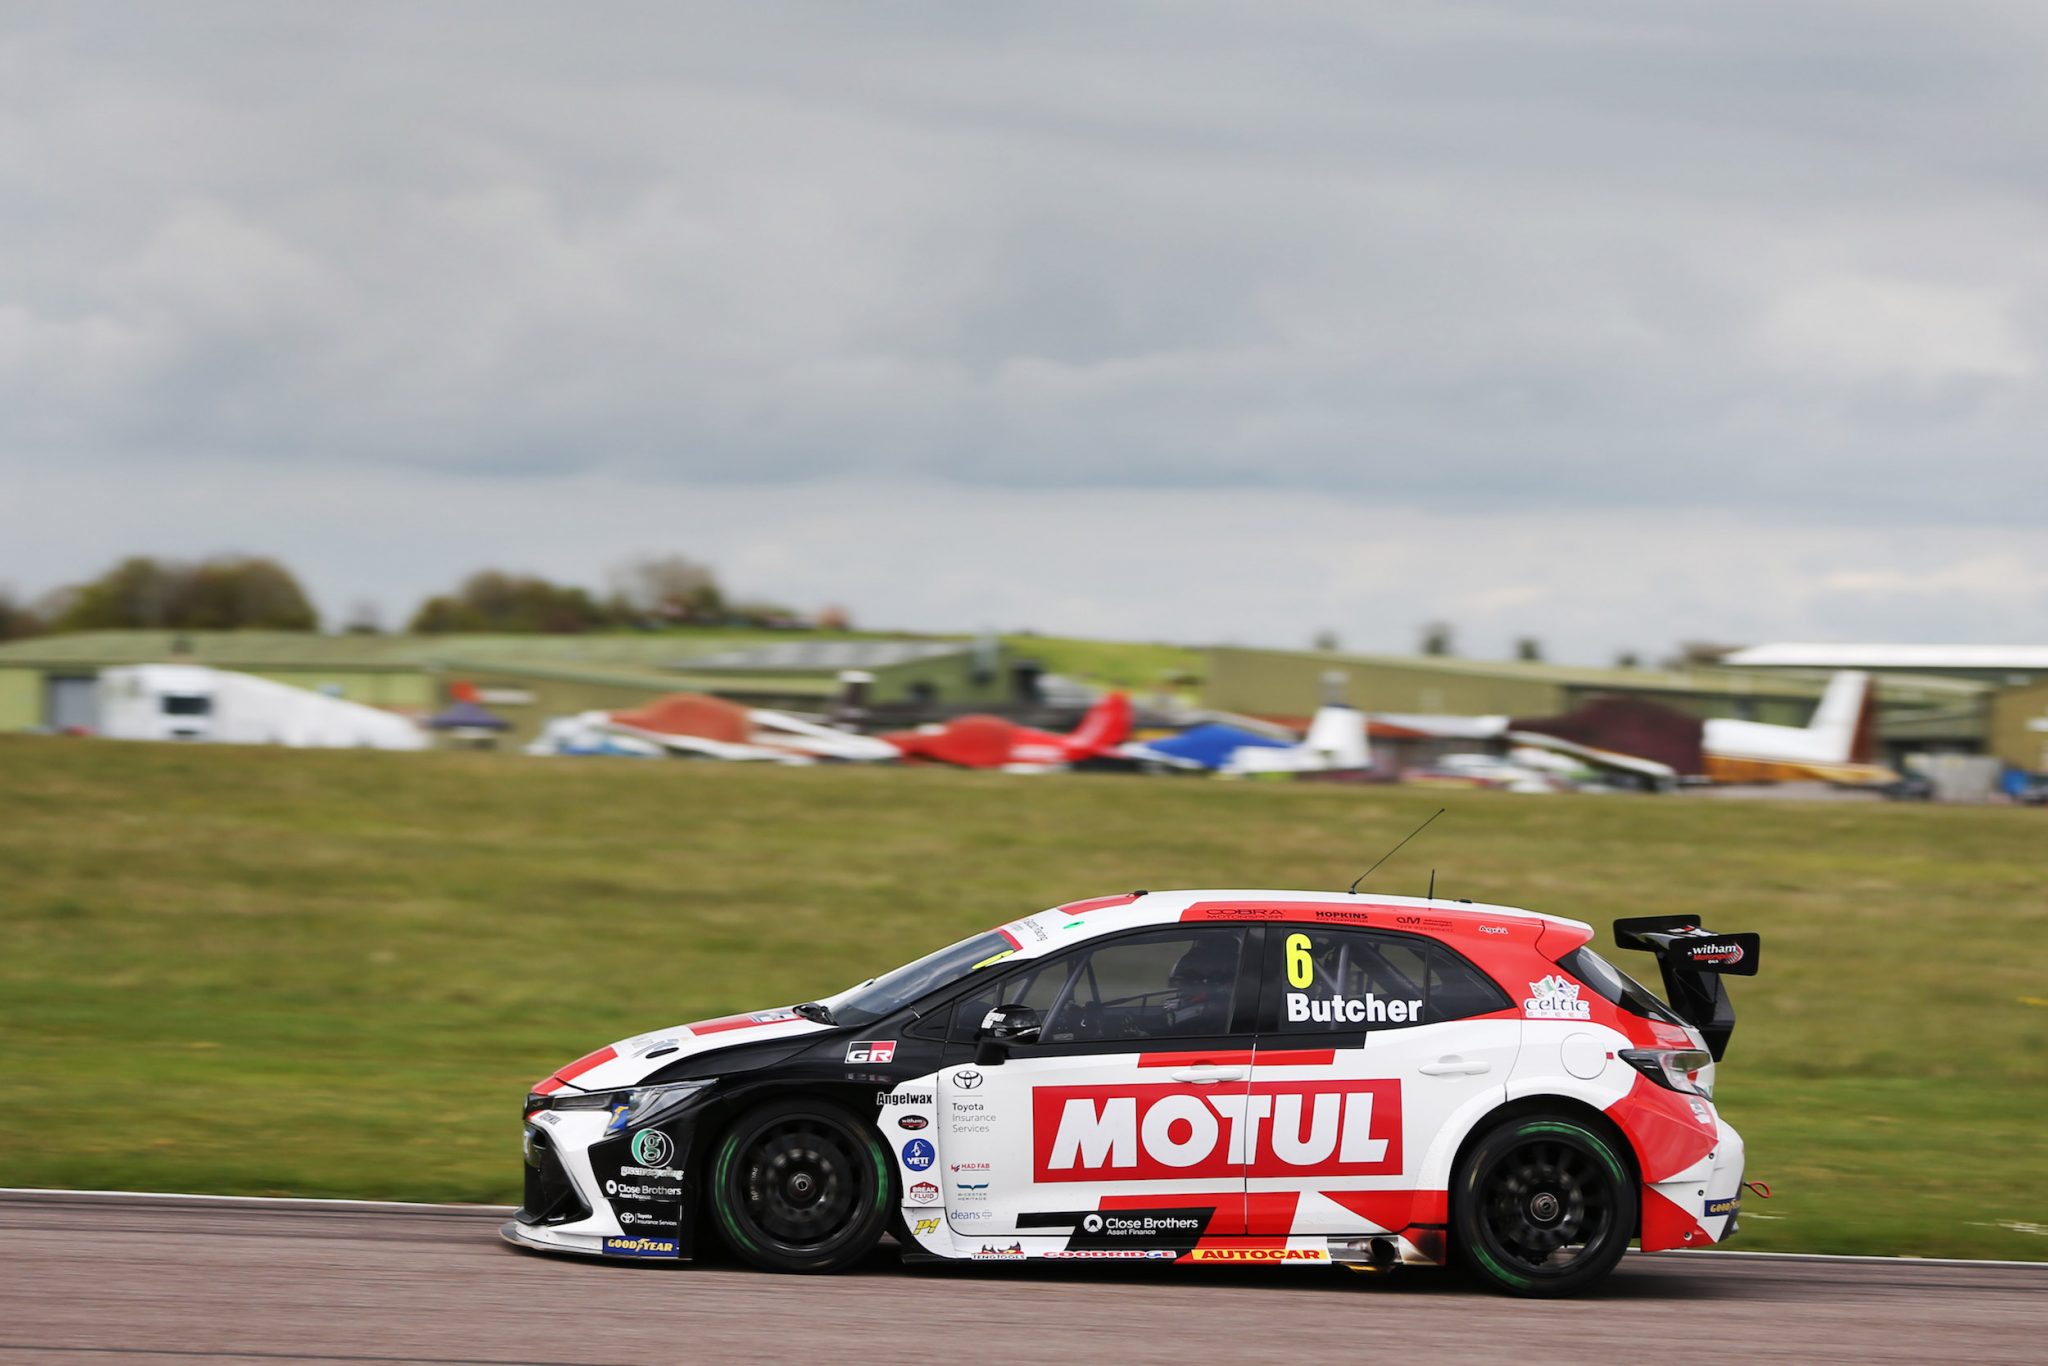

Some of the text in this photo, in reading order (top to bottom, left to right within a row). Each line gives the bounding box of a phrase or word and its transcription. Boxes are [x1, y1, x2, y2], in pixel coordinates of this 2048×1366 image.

[1316, 911, 1368, 919] HOPKINS
[1693, 944, 1737, 954] witham
[1285, 933, 1314, 989] 6
[1286, 992, 1423, 1023] Butcher
[847, 1050, 892, 1062] GR
[877, 1092, 933, 1106] Angelwax
[952, 1102, 984, 1112] Toyota
[952, 1113, 997, 1121] Insurance
[952, 1124, 990, 1133] Services
[1047, 1092, 1389, 1170] MOTUL
[907, 1156, 929, 1165] YETI
[618, 1184, 682, 1196] Close Brothers
[951, 1209, 980, 1220] deans
[1106, 1218, 1199, 1228] Close Brothers
[607, 1238, 673, 1252] GOODYEAR
[1043, 1251, 1176, 1259] GOODRIDGE
[1201, 1250, 1320, 1259] AUTOCAR
